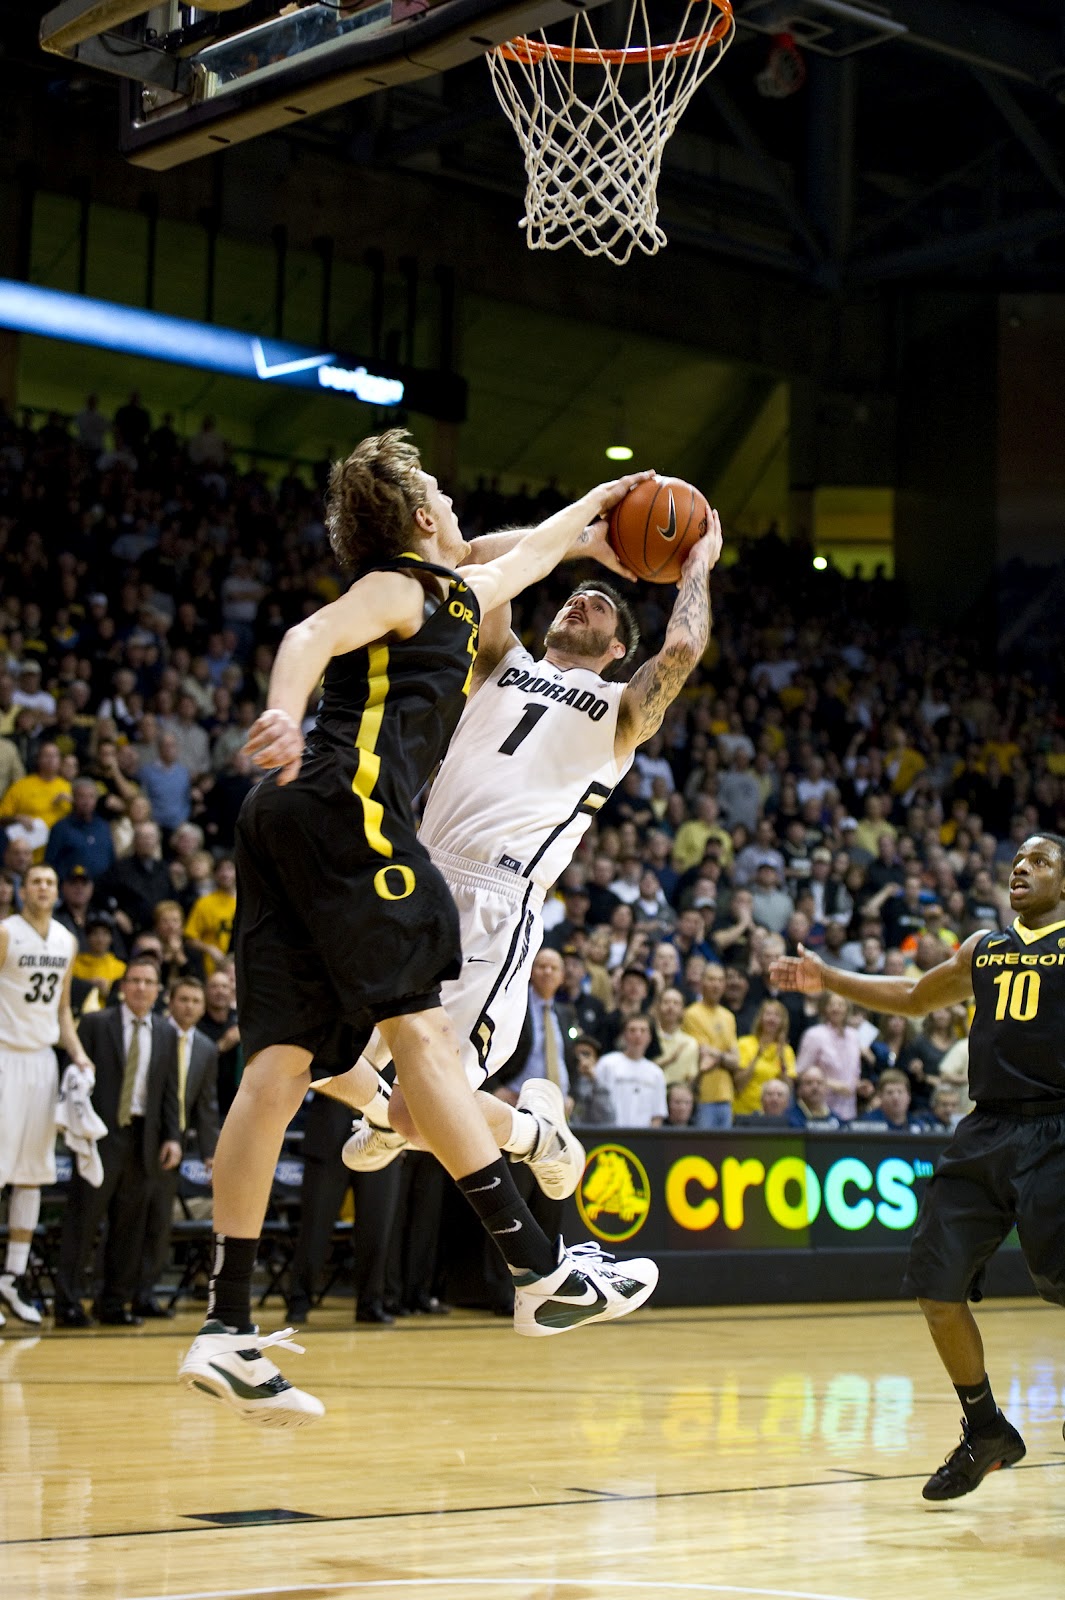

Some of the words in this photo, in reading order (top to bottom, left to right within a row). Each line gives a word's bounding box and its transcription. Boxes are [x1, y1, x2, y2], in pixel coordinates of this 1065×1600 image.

[497, 667, 609, 722] COLORADO
[498, 702, 549, 756] 1
[373, 864, 416, 900] O
[25, 972, 59, 1003] 33
[993, 969, 1041, 1021] 10
[665, 1155, 918, 1231] crocs
